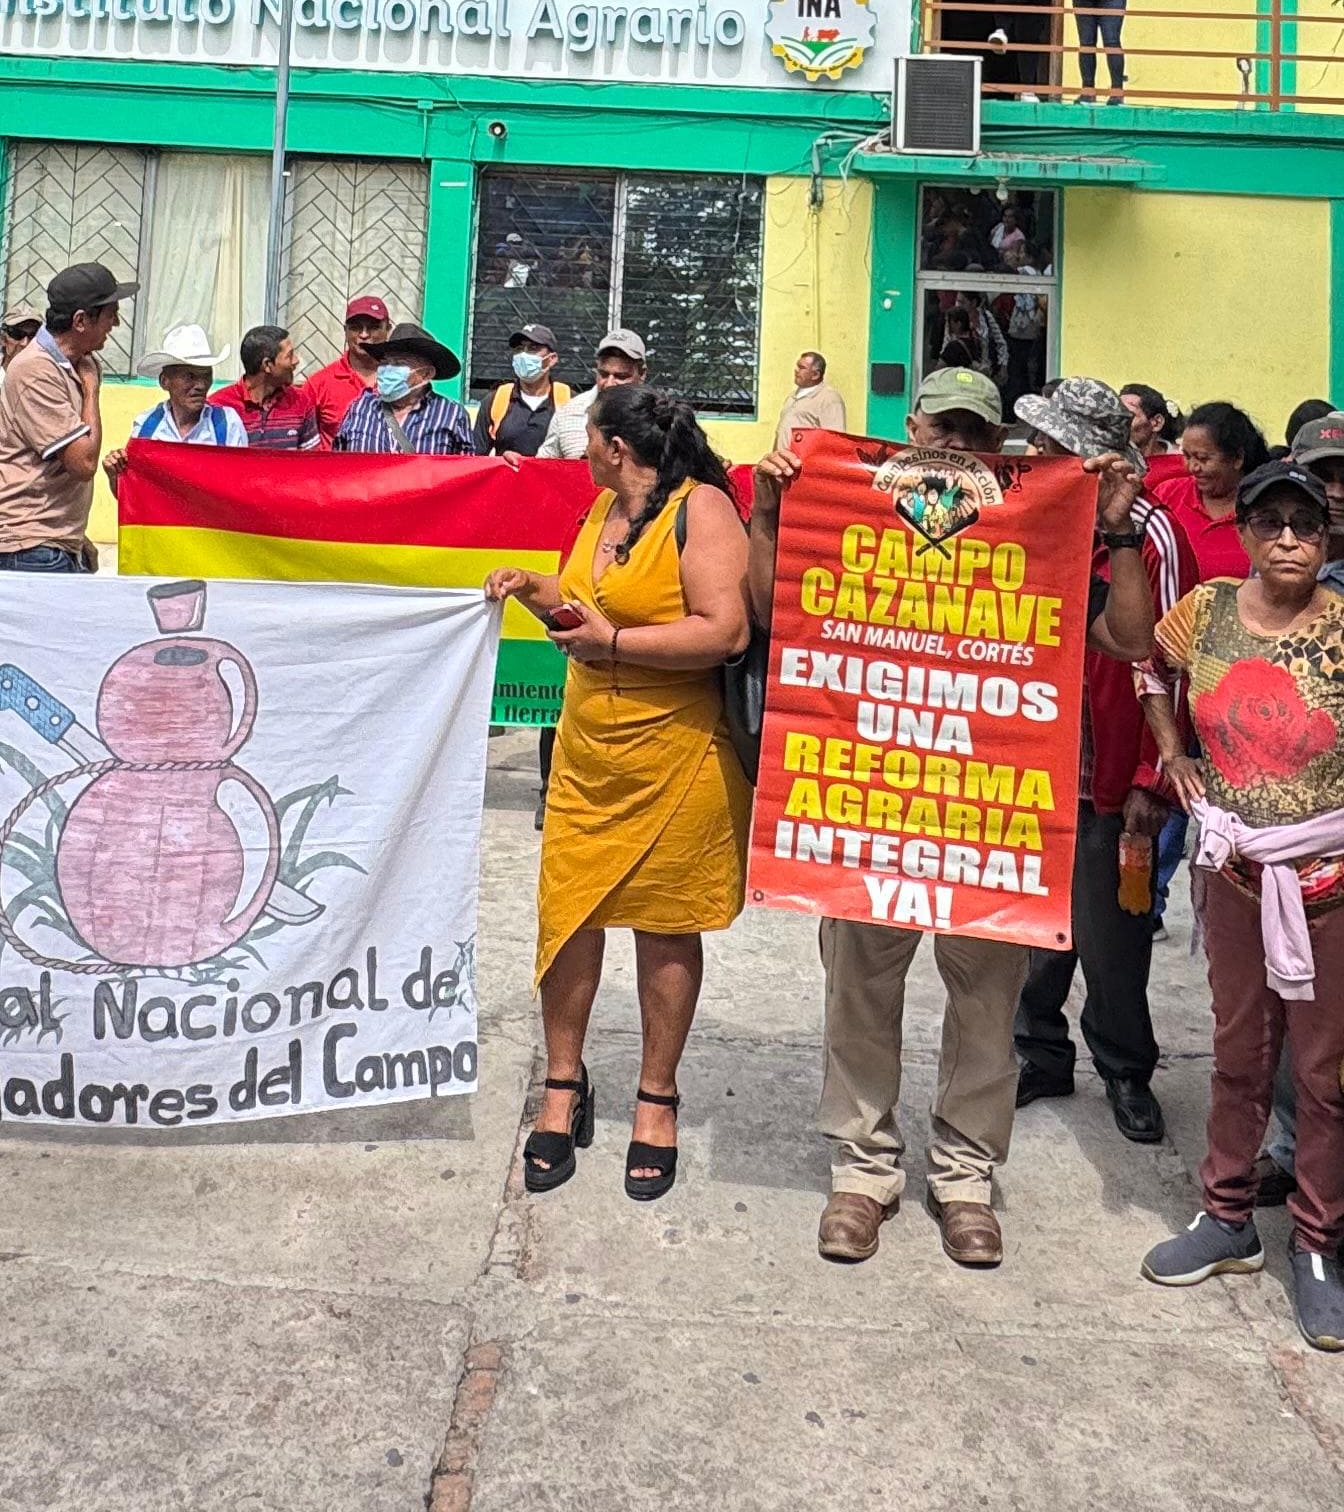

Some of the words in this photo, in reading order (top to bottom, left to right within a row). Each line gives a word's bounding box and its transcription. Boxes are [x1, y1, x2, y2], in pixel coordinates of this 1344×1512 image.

[877, 448, 947, 491] Campesinos
[948, 452, 966, 466] en
[965, 460, 996, 504] Acción
[841, 524, 1027, 591] CAMPO
[800, 566, 1063, 647] CAZANAVE
[821, 619, 862, 642] SAN
[863, 626, 952, 659] MANUEL,
[957, 638, 1035, 666] CORTÉS
[779, 647, 1059, 722] EXIGIMOS
[856, 700, 974, 756] UNA
[783, 731, 1056, 811] REFORMA
[783, 777, 1044, 851] AGRARIA
[774, 820, 1050, 897] INTEGRAL
[862, 875, 954, 930] YA!
[93, 945, 389, 1042] Nacional
[401, 944, 460, 1010] de
[228, 1038, 302, 1112] del
[323, 1022, 478, 1098] Campo
